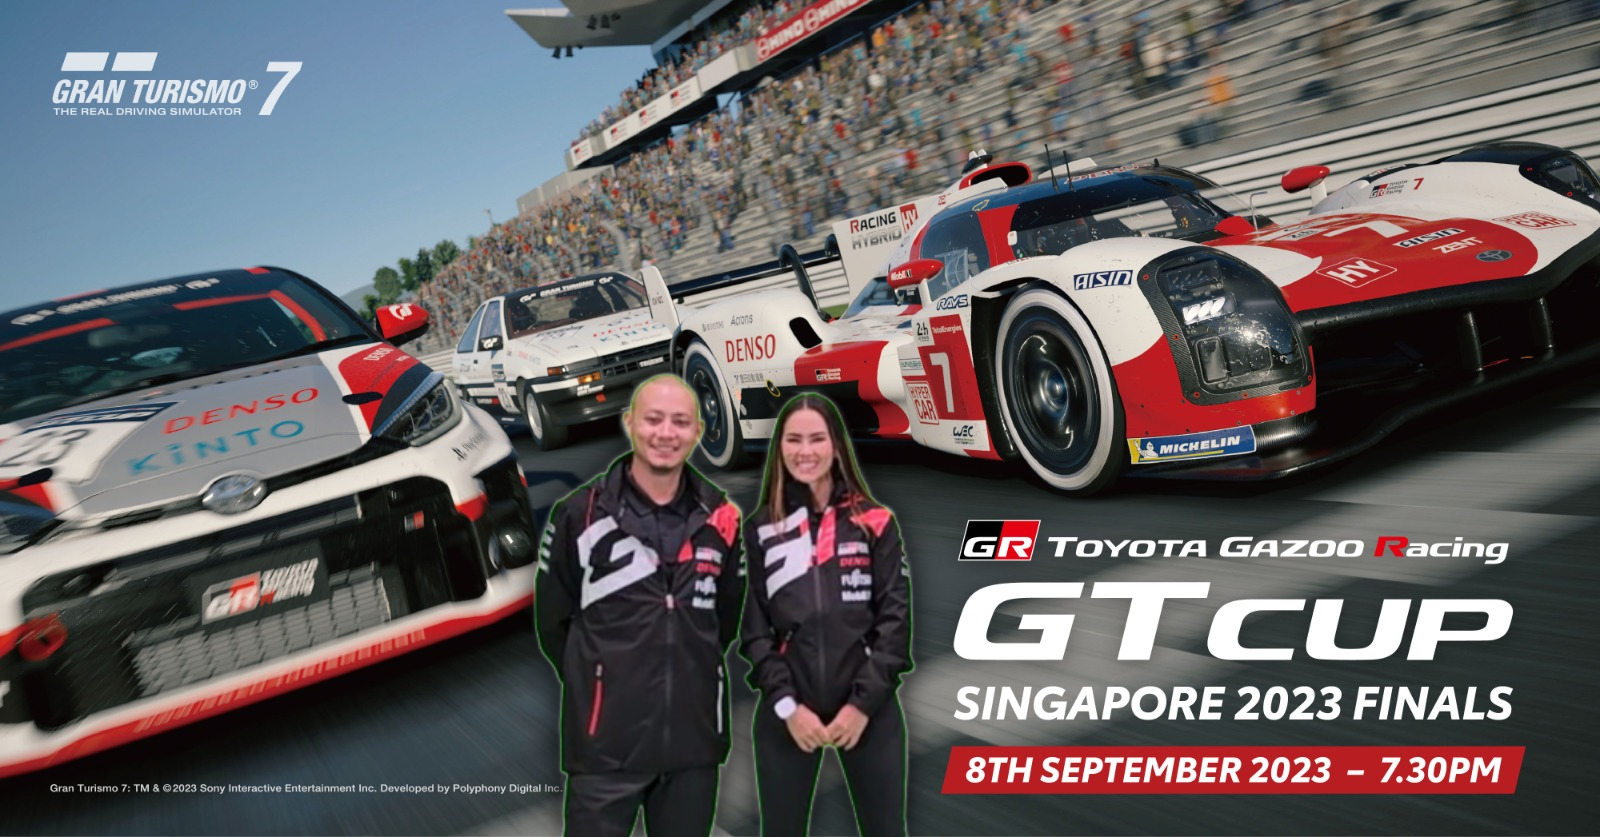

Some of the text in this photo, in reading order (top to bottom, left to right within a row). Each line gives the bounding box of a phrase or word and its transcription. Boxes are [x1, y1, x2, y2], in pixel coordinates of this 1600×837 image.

[1413, 178, 1425, 190] 7
[850, 212, 897, 234] RACING
[852, 226, 902, 250] HYBRID
[1432, 237, 1484, 254] ZENT
[1075, 270, 1132, 289] AISIN
[1327, 259, 1381, 282] HY
[937, 294, 969, 311] RAYS
[730, 313, 754, 328] Acronis
[725, 333, 777, 363] DENSO
[909, 386, 930, 398] HYPER
[929, 352, 955, 413] 7
[162, 387, 319, 435] DENSO
[914, 400, 938, 420] CAR
[1159, 435, 1240, 454] MICHELIN
